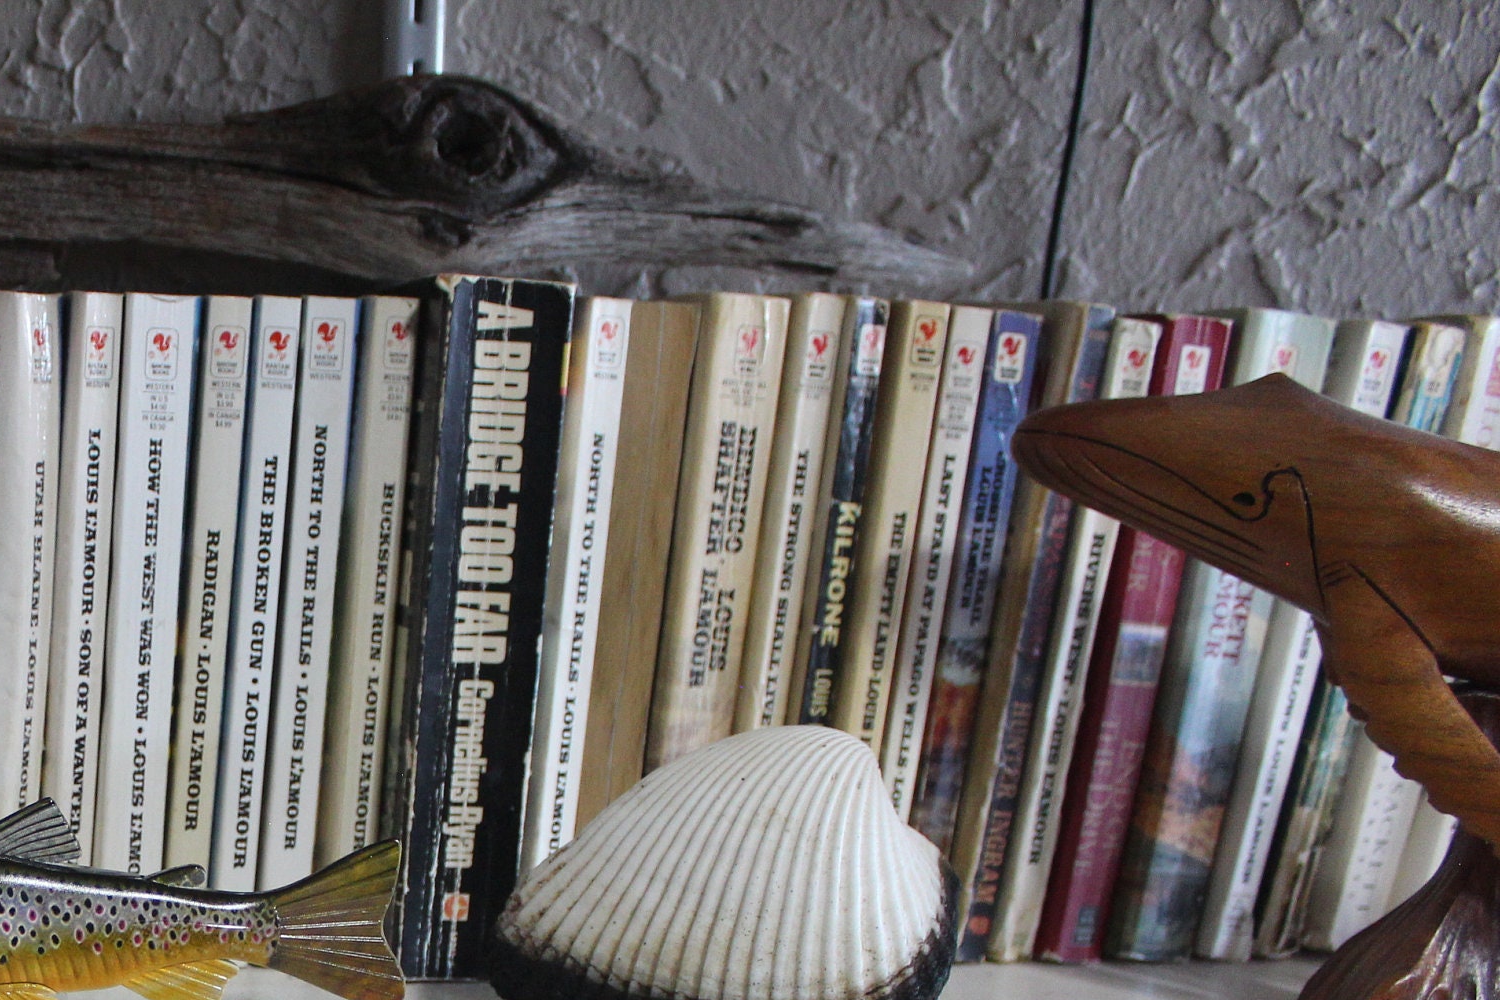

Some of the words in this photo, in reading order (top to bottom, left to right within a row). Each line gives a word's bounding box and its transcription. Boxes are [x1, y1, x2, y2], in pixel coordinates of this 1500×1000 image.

[476, 300, 535, 332] A
[463, 338, 533, 494] BRIDGE
[33, 460, 45, 528] UTAH
[85, 429, 101, 504] LOUIS
[147, 438, 163, 495] HOW
[263, 455, 279, 506] THE
[309, 424, 329, 505] NORTH
[584, 433, 605, 515] NORTH
[706, 420, 738, 555] SHAFTER
[792, 450, 810, 497] THE
[937, 454, 957, 509] LAST
[145, 499, 160, 547] THE
[307, 509, 323, 539] TO
[375, 482, 396, 609] BUCKSKIN
[457, 502, 519, 584] TOO
[582, 518, 597, 549] TO
[780, 503, 804, 591] STRONG
[928, 512, 947, 581] STAND
[29, 534, 43, 628] BLAINE
[80, 508, 99, 616] L'AMOUR
[141, 552, 158, 613] WEST
[200, 528, 221, 641] RADIGAN
[252, 511, 275, 614] BROKEN
[304, 544, 320, 591] THE
[575, 558, 593, 605] THE
[819, 501, 863, 649] KILRONE
[1075, 532, 1106, 619] RIVERS
[78, 628, 93, 679] SON
[138, 618, 155, 668] WAS
[250, 621, 267, 670] GUN
[299, 594, 317, 667] RAILS
[369, 613, 386, 663] RUN
[451, 590, 511, 665] FAR
[567, 611, 585, 684] RAILS
[709, 588, 736, 672] LOUIS
[768, 597, 790, 671] SHALL
[871, 620, 892, 671] LAND
[910, 616, 931, 698] PAPAGO
[1061, 621, 1087, 685] WEST
[24, 638, 38, 710] LOUIS
[76, 682, 91, 710] OF
[135, 670, 152, 720] WON
[192, 653, 211, 725] LOUIS
[760, 674, 779, 726] LIVE
[809, 667, 833, 718] LOUIS
[862, 677, 882, 738] LOUIS
[242, 691, 260, 763] LOUIS
[292, 684, 309, 754] LOUIS
[362, 675, 380, 747] LOUIS
[449, 679, 495, 804] Cornelius
[558, 695, 577, 767] LOUIS
[897, 700, 918, 768] WELLS
[1046, 700, 1072, 765] LOUIS
[69, 735, 87, 834] WANTED
[131, 738, 147, 812] LOUIS
[184, 729, 205, 832] L'AMOUR
[998, 700, 1033, 802] HUNTER
[232, 766, 254, 869] L'AMOUR
[284, 756, 304, 851] L'AMOUR
[442, 805, 484, 869] Ryan
[975, 807, 1012, 905] INGRAM
